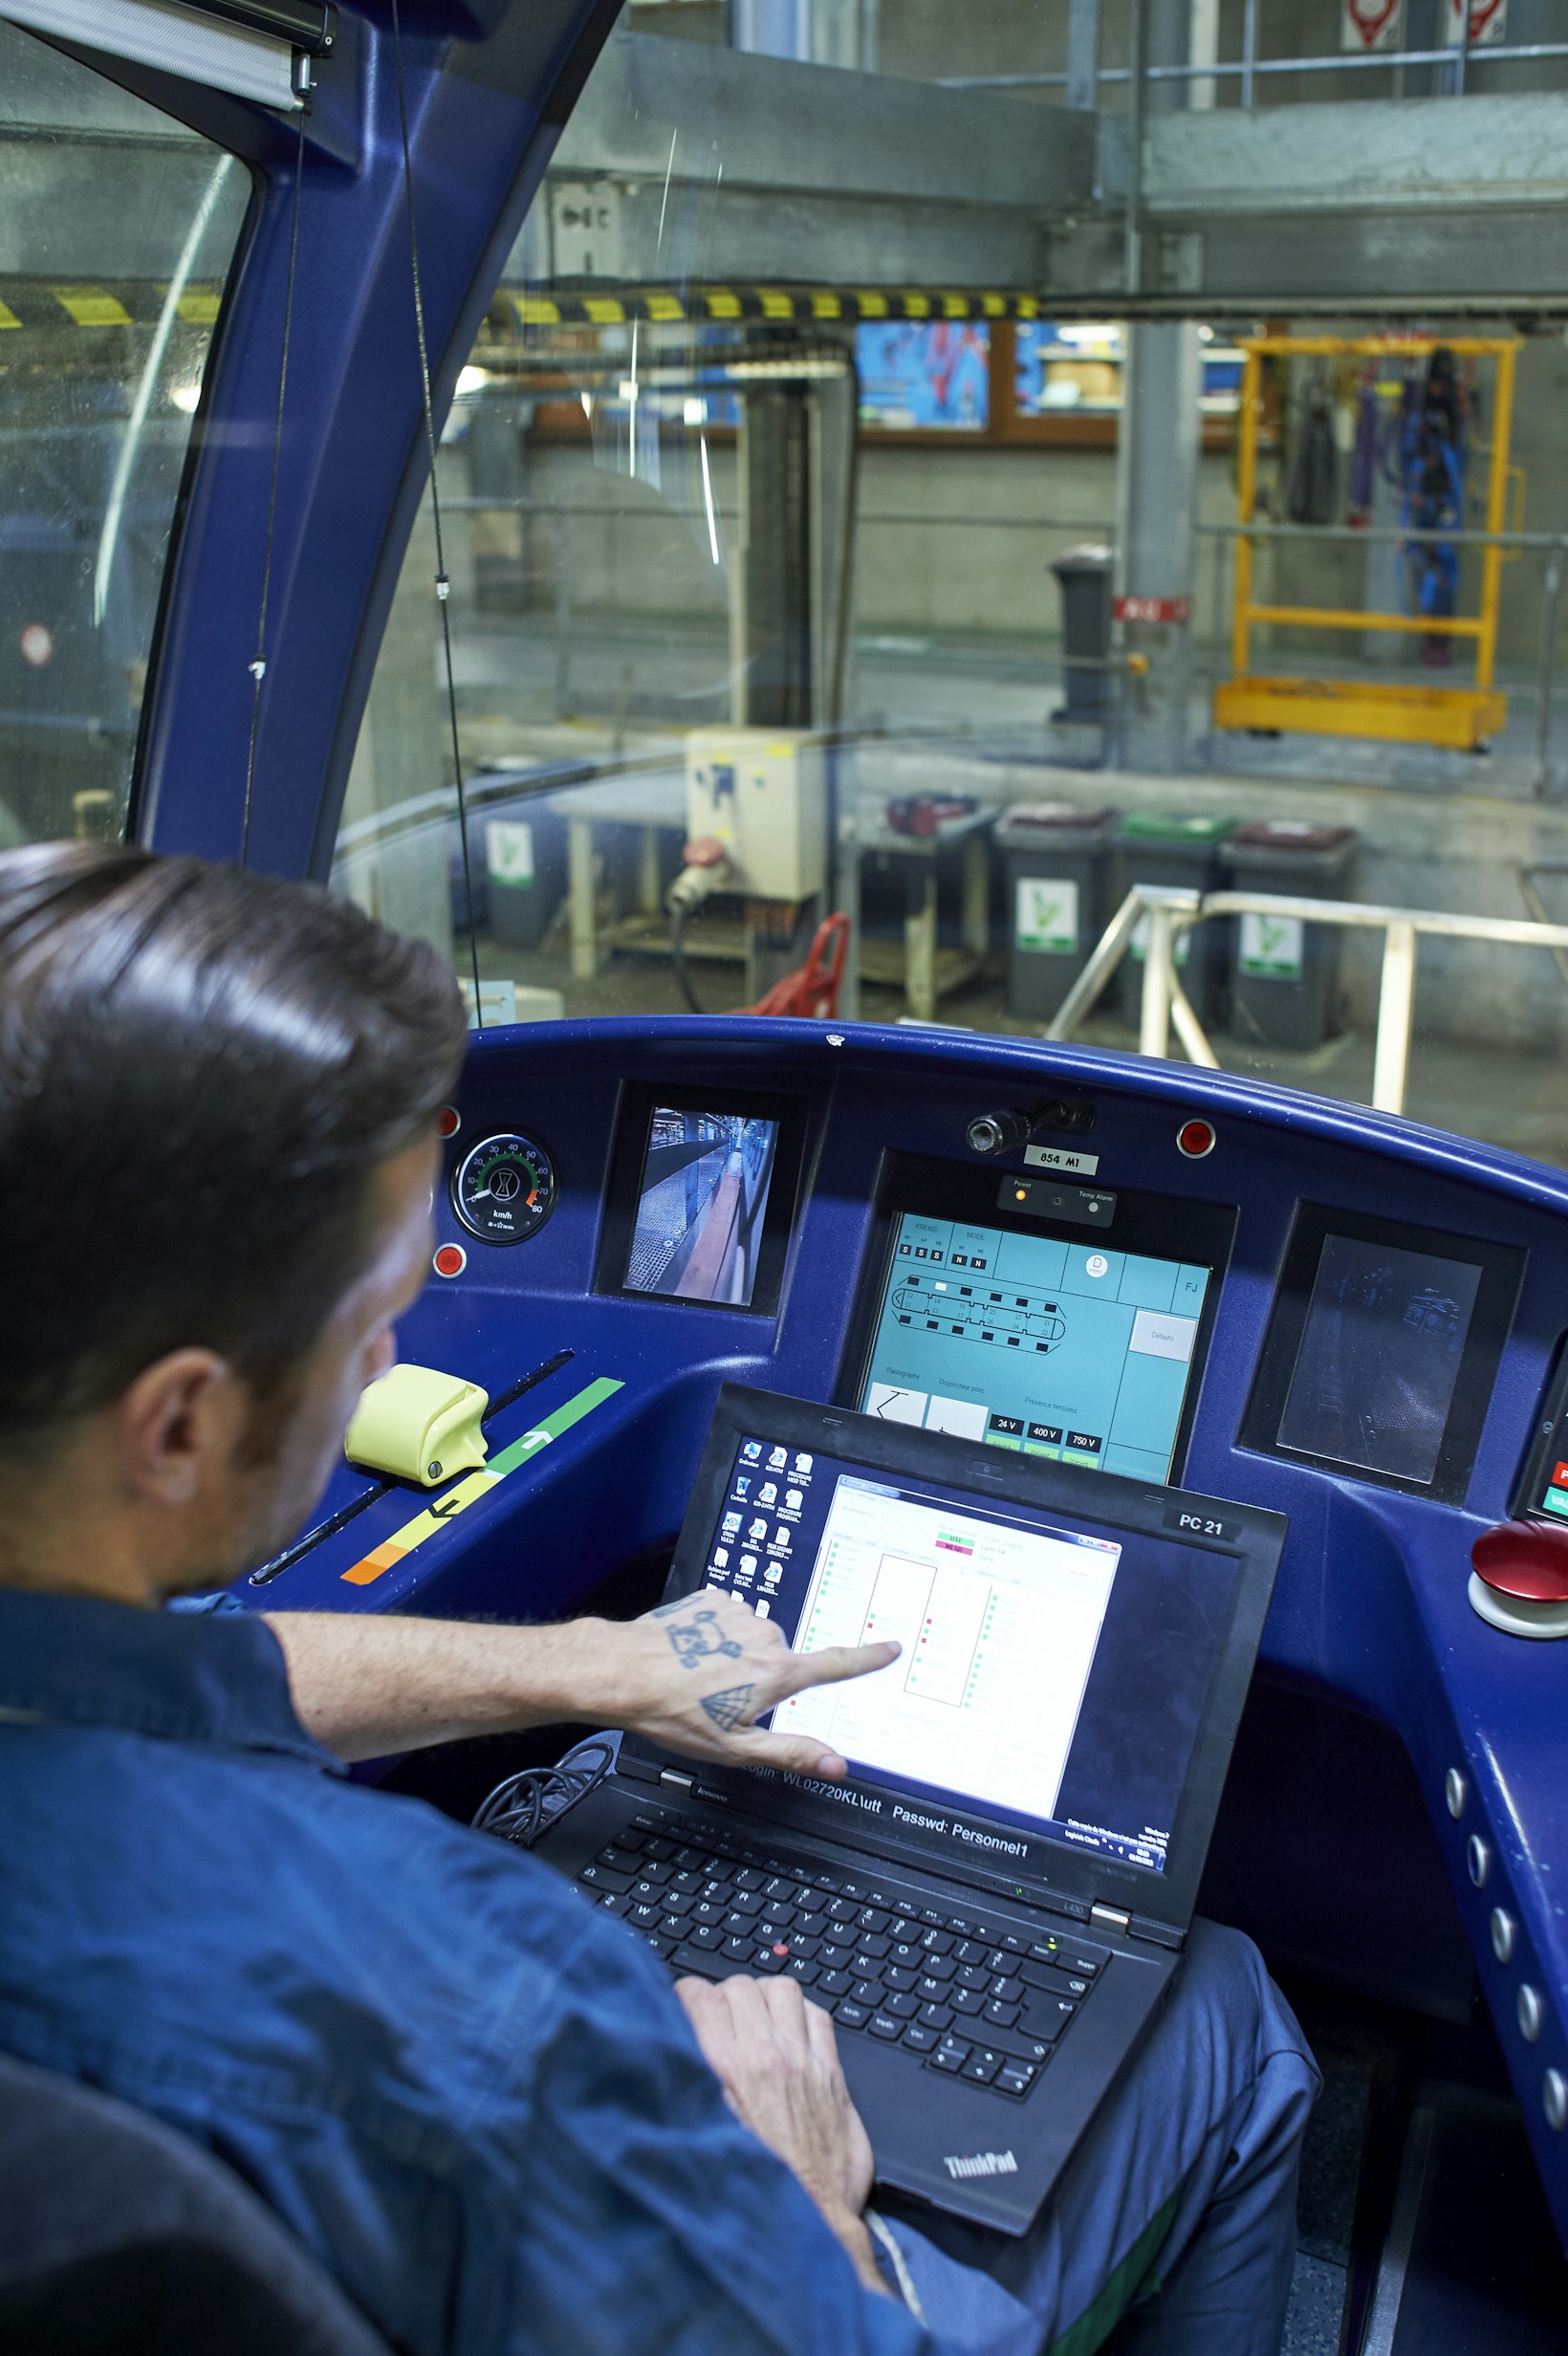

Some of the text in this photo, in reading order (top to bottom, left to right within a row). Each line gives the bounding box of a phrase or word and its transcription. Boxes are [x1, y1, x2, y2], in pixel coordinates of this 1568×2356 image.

[527, 1150, 536, 1159] 50
[1040, 1153, 1060, 1164] 854
[1013, 1180, 1033, 1189] Power
[1078, 1190, 1096, 1200] Temp
[533, 1205, 543, 1213] 80
[493, 1210, 512, 1220] km/h
[915, 1224, 938, 1233] FREINS
[967, 1232, 986, 1241] MODE
[956, 1255, 982, 1268] N N
[1186, 1281, 1198, 1293] FJ
[997, 1419, 1016, 1429] 24 V
[1034, 1427, 1056, 1439] 400 V
[1073, 1435, 1096, 1448] 750 V
[1179, 1514, 1223, 1536] PC 21
[697, 1786, 728, 1802] lenovo
[893, 1804, 947, 1834] Passwd:
[638, 1905, 651, 1915] W
[773, 1901, 780, 1910] T
[667, 1915, 678, 1926] X
[804, 1912, 812, 1922] Y
[834, 1923, 843, 1932] U
[731, 1937, 741, 1947] V
[795, 1934, 805, 1945] H
[899, 1945, 908, 1955] O
[795, 1958, 805, 1970] N
[925, 1977, 937, 1990] M
[943, 2149, 1018, 2179] ThinkPad
